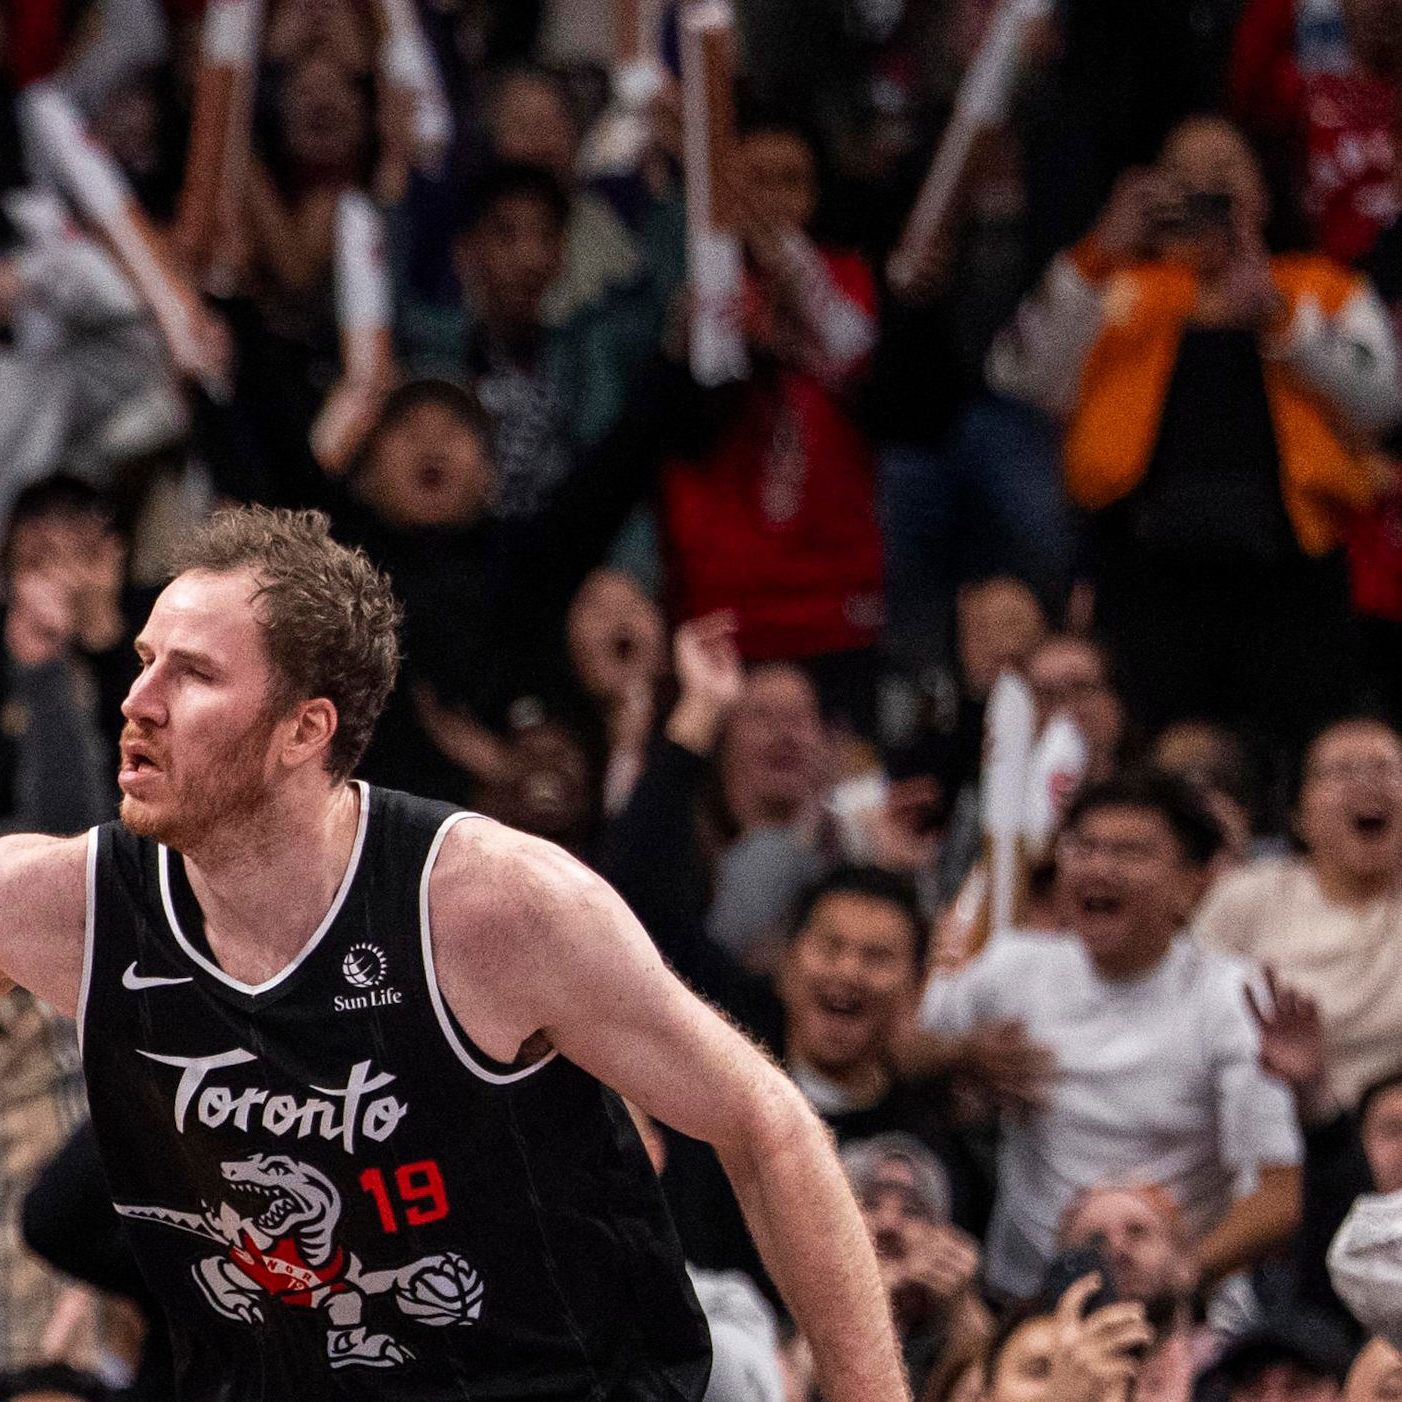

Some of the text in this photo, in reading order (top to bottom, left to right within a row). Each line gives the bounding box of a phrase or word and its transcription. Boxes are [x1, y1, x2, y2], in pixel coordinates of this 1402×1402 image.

[334, 987, 403, 1012] Sun Life
[135, 1048, 408, 1154] Toronto
[359, 1158, 450, 1234] 19
